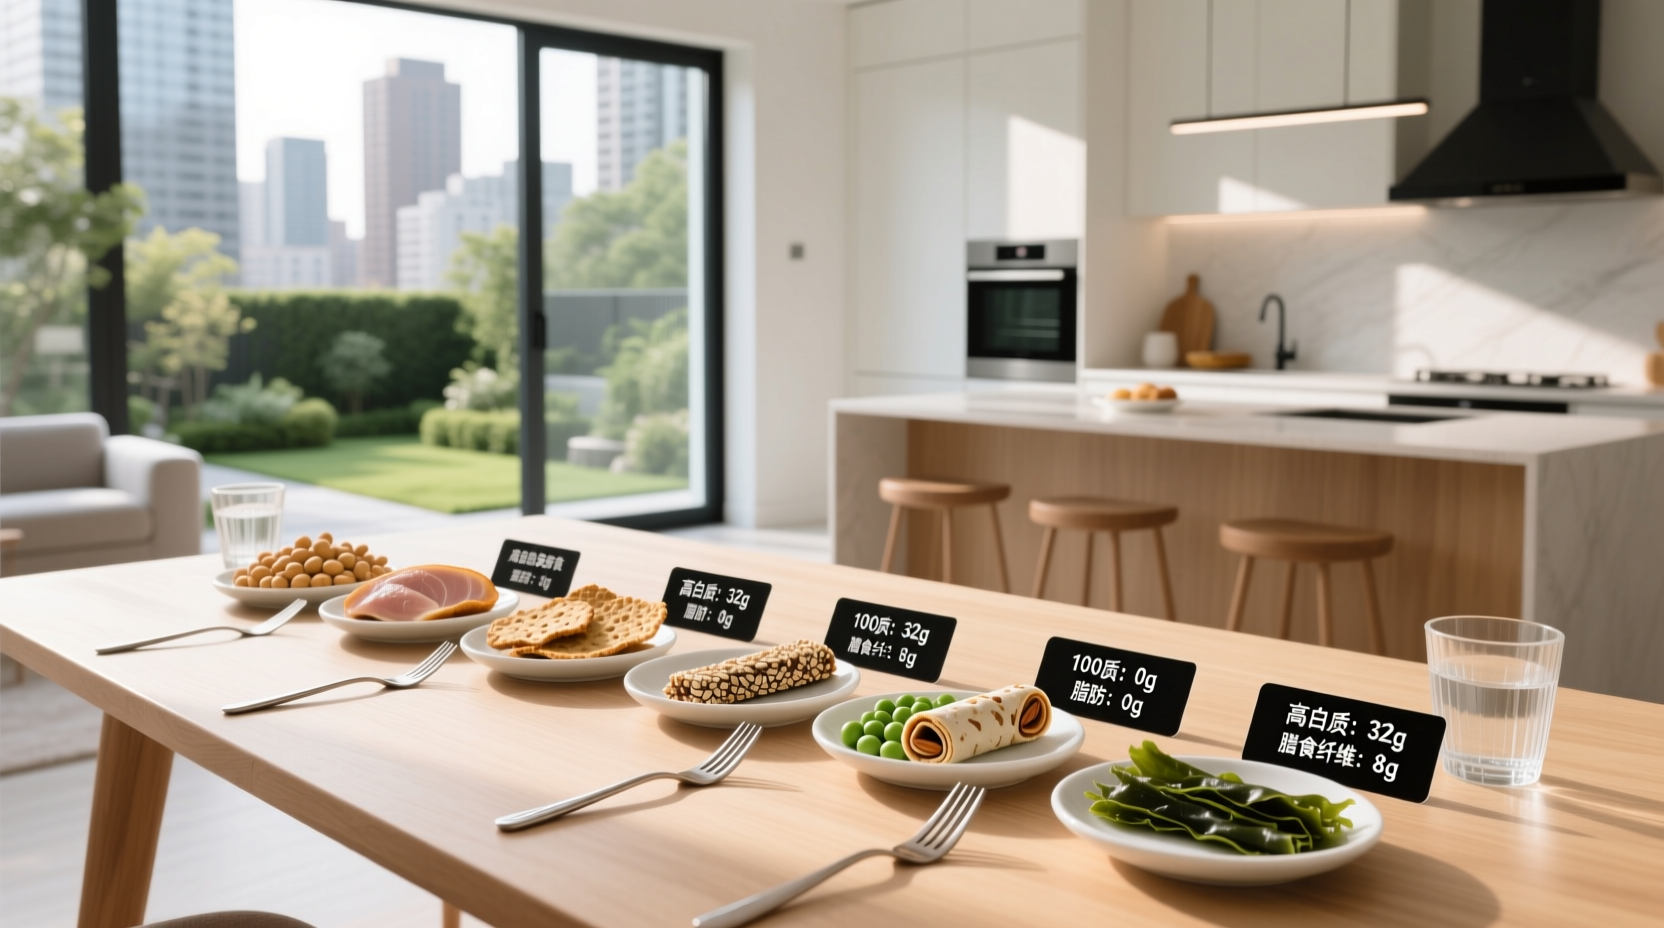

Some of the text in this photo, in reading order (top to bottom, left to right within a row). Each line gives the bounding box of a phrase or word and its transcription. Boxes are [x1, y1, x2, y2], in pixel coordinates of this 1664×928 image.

[726, 588, 750, 610] 32g
[718, 610, 733, 629] 0g
[901, 622, 930, 646] 32g
[899, 647, 917, 669] 8g
[1134, 667, 1157, 693] 0g
[1121, 694, 1143, 718] 0g
[1367, 720, 1407, 752] 32g
[1373, 754, 1399, 782] 8g
